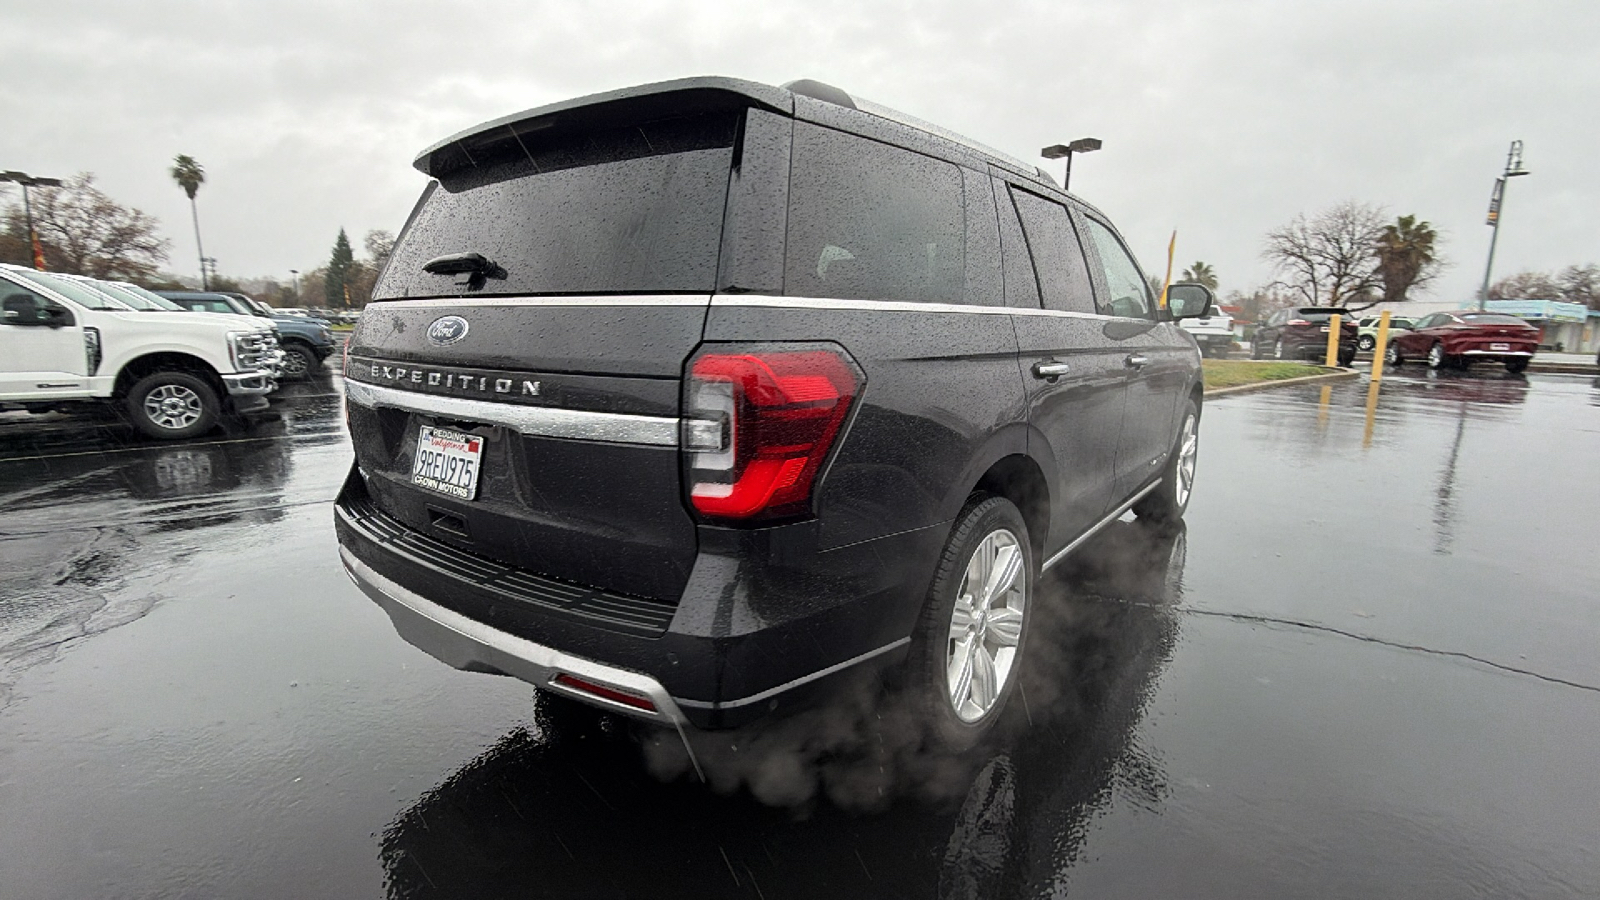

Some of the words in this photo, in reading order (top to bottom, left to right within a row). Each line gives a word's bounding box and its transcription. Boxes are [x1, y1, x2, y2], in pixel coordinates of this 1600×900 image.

[432, 320, 458, 337] Ford
[370, 365, 541, 396] EXPEDITION
[433, 428, 466, 441] REDDING
[430, 437, 469, 453] California
[418, 449, 474, 488] 9REU975
[414, 475, 438, 490] CROWN
[438, 482, 468, 498] MOTORS
